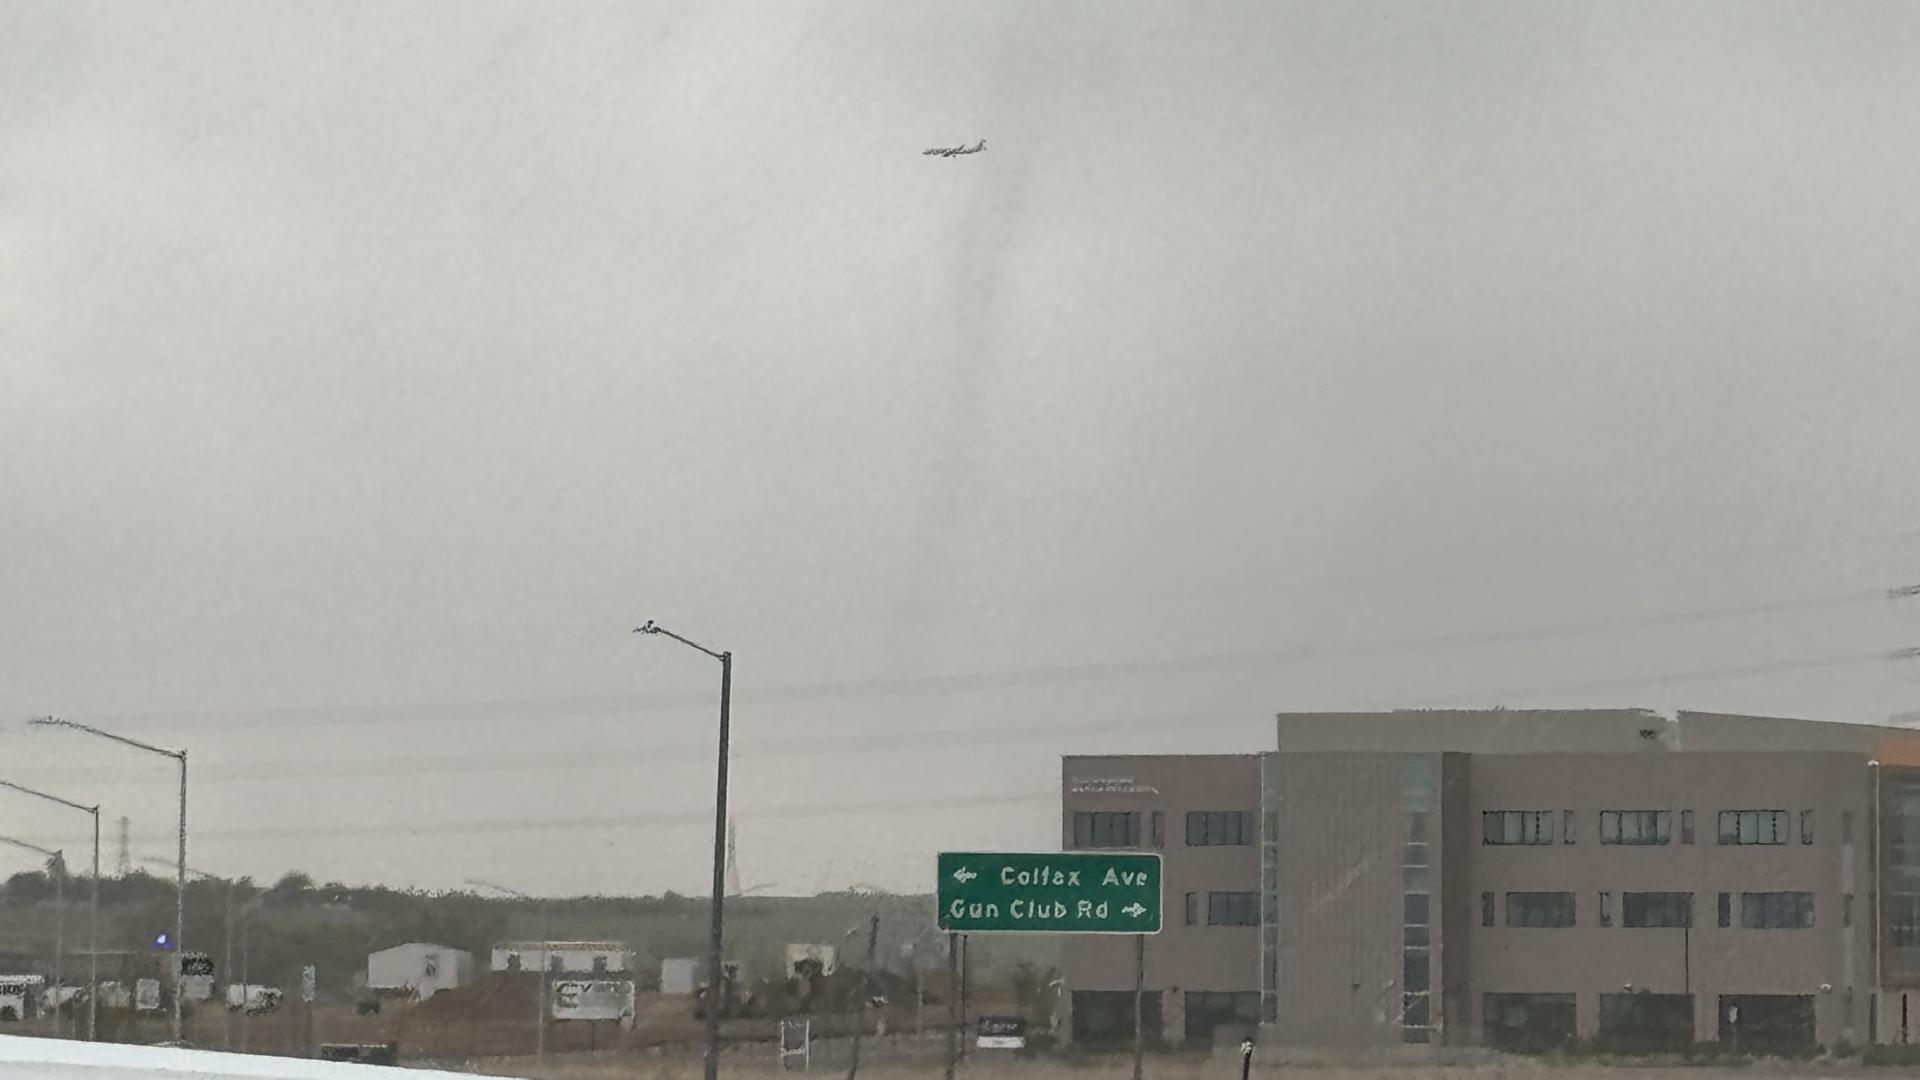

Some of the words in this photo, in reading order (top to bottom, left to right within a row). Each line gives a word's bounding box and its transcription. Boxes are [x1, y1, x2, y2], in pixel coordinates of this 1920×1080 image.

[1001, 866, 1081, 886] Colfax
[1101, 867, 1147, 886] Ave
[950, 899, 999, 919] Gun
[1009, 899, 1067, 919] Club
[1077, 900, 1108, 919] Rd
